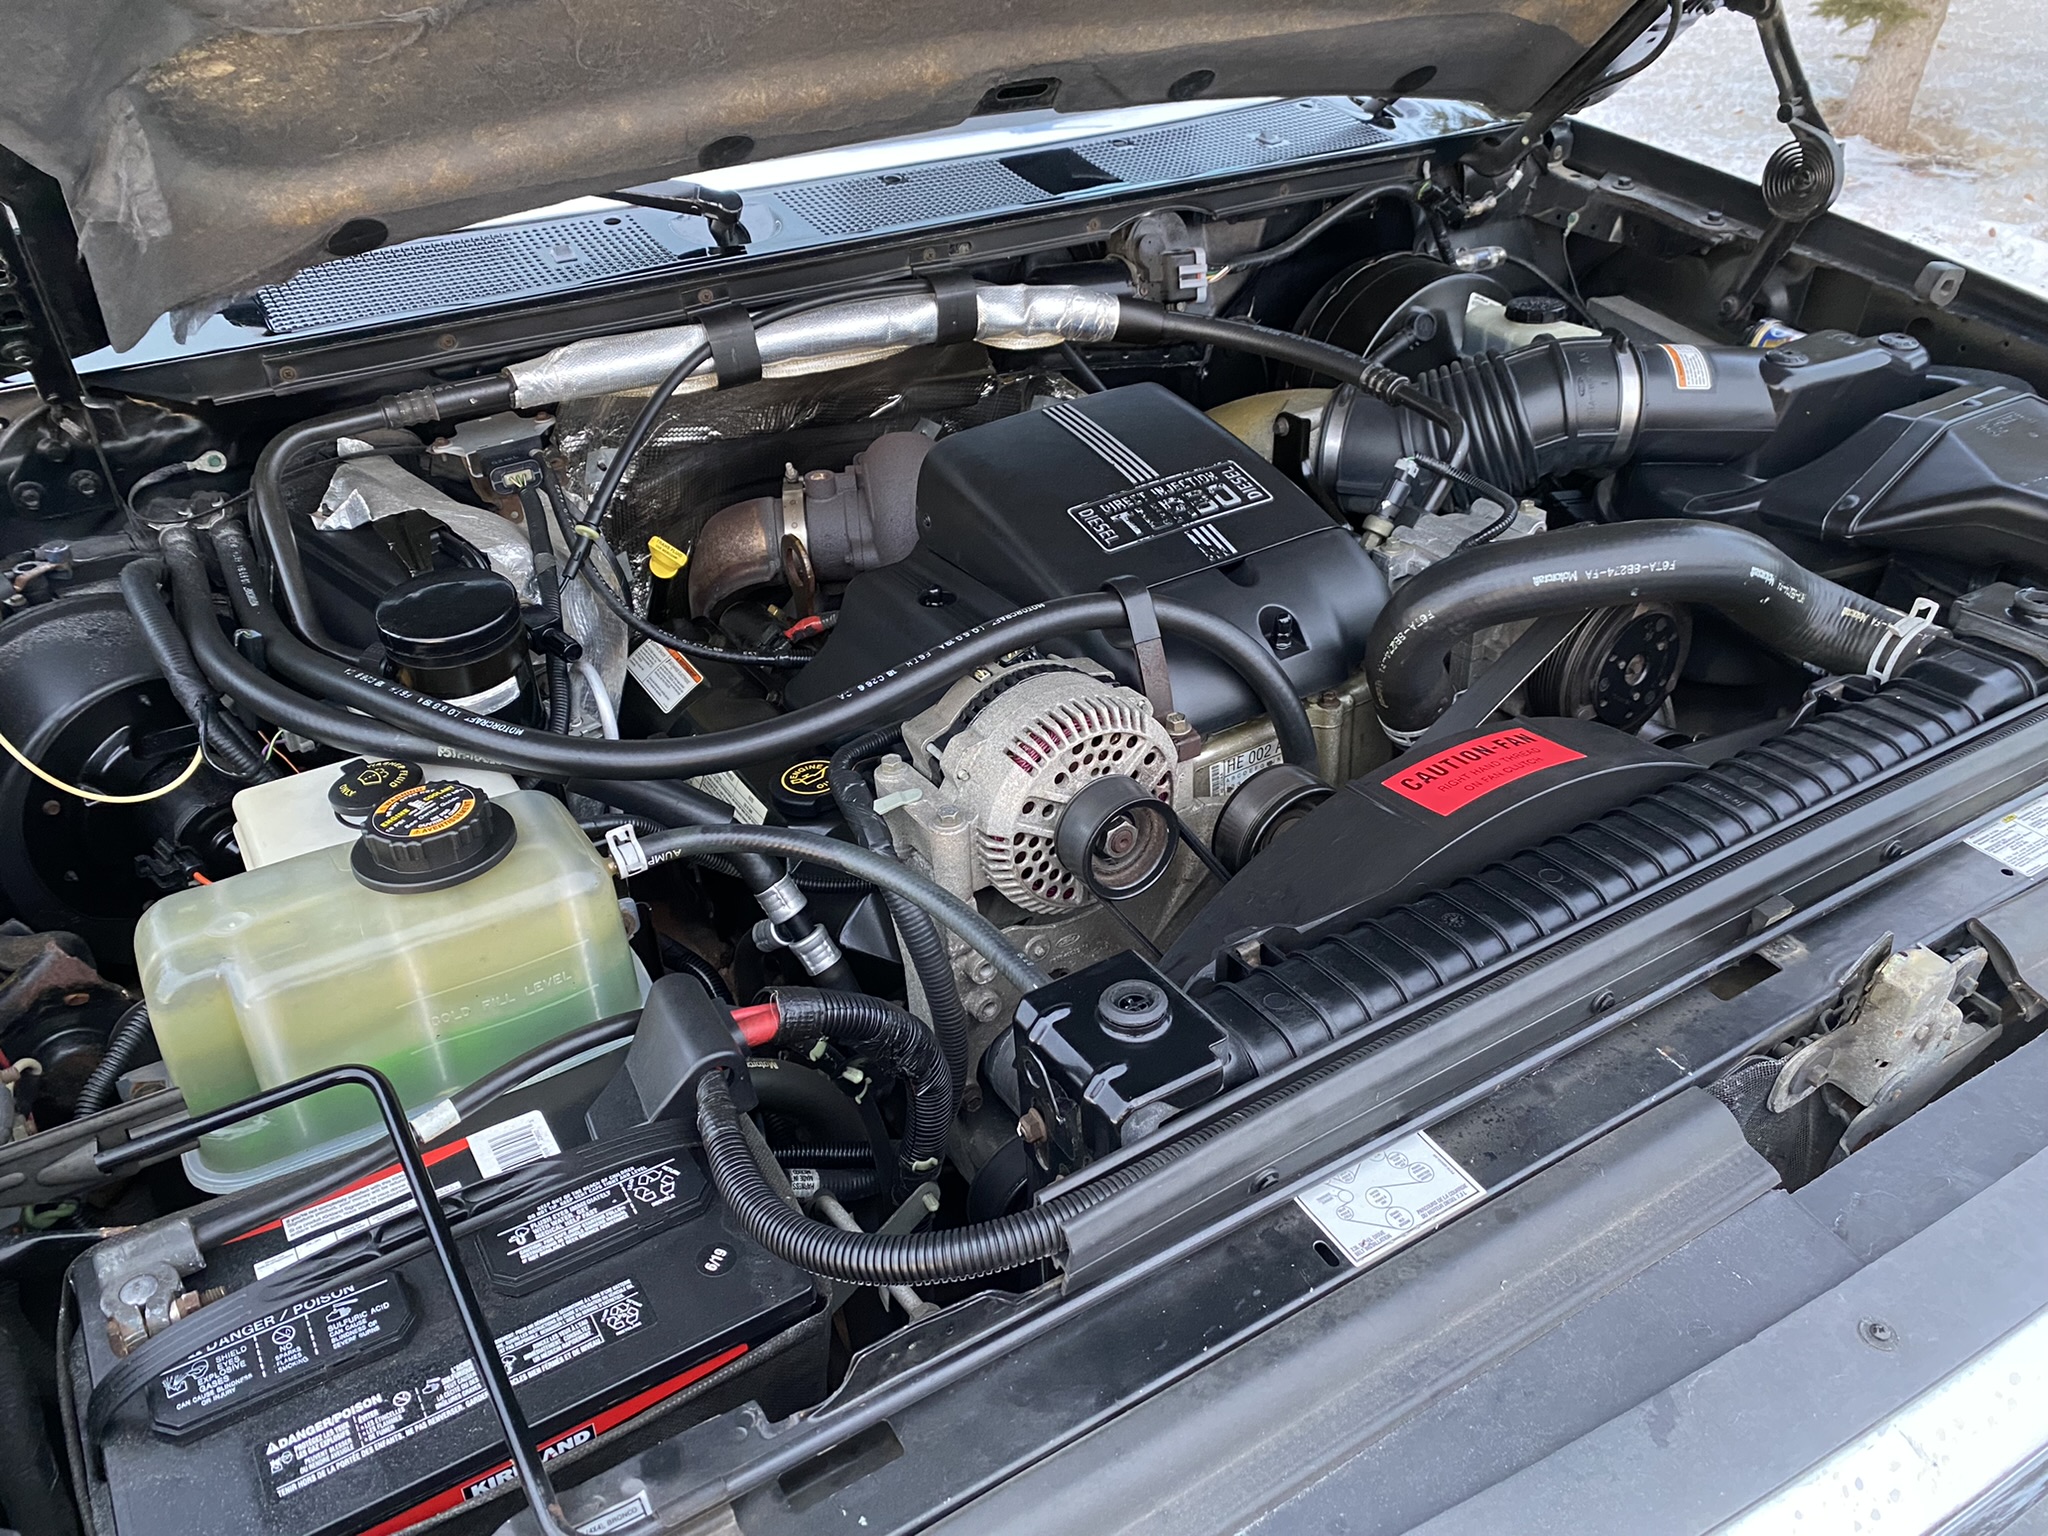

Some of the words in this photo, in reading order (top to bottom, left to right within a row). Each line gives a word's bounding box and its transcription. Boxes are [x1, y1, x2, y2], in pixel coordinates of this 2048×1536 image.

[1221, 466, 1264, 500] DIESEL
[1078, 508, 1120, 546] DIESEL
[990, 596, 1045, 631] MOTORCRAFT
[463, 709, 524, 739] MOTORCRAFT
[1227, 755, 1244, 773] HE
[1249, 744, 1272, 764] 002
[1400, 733, 1538, 791] CAUTION-FAN
[1437, 773, 1473, 793] RIGHT
[1470, 759, 1501, 776] HAND
[1500, 747, 1541, 763] THREAD
[790, 764, 824, 779] ENGINE
[1464, 780, 1483, 792] ON
[1481, 771, 1504, 784] FAN
[1502, 757, 1544, 774] CLUTCH
[339, 784, 357, 797] ONLY
[378, 806, 411, 828] ENGINE
[422, 782, 455, 803] COOLANT
[481, 992, 516, 1010] FILL
[524, 970, 572, 996] LEVEL
[608, 1165, 634, 1180] CHILDREN
[630, 1165, 647, 1175] LEVEL
[529, 1215, 552, 1230] FLUSH
[551, 1208, 569, 1219] EYES
[568, 1189, 611, 1212] IMMEDIATELY
[532, 1222, 551, 1234] WITH
[575, 1205, 589, 1215] GET
[534, 1224, 561, 1239] MEDICAL
[561, 1215, 580, 1227] HELP
[579, 1207, 598, 1219] FAST
[204, 1314, 277, 1351] DANGER
[292, 1283, 356, 1315] POISON
[326, 1309, 370, 1332] SULFURIC
[369, 1300, 390, 1315] ACID
[328, 1327, 344, 1338] CAN
[344, 1317, 368, 1331] CAUSE
[329, 1324, 368, 1343] BLINDNESS
[367, 1319, 378, 1328] OR
[356, 1324, 380, 1339] BURNS
[214, 1344, 248, 1363] SHIELD
[273, 1345, 302, 1361] SPARKS
[278, 1341, 293, 1352] NO
[215, 1354, 240, 1370] EYES
[275, 1351, 303, 1367] FLAMES
[277, 1355, 309, 1373] SMOKING
[195, 1359, 247, 1386] EXPLOSIVE
[197, 1374, 231, 1393] GASES
[175, 1399, 191, 1410] CAN
[191, 1388, 216, 1403] CAUSE
[200, 1396, 212, 1406] OR
[212, 1386, 237, 1401] INJURY
[276, 1392, 384, 1449] DANGER/POISON
[363, 1419, 374, 1429] LES
[366, 1425, 377, 1434] LES
[367, 1432, 376, 1440] DE
[276, 1481, 298, 1498] TENIR
[296, 1473, 316, 1488] HORS
[314, 1468, 326, 1479] DE
[324, 1463, 336, 1474] LA
[334, 1451, 361, 1469] PORTÉE
[359, 1445, 374, 1457] DES
[413, 1420, 427, 1432] PAS
[306, 1443, 320, 1454] GAZ
[470, 1430, 591, 1498] KIRAND
[607, 1506, 639, 1526] BRONCO
